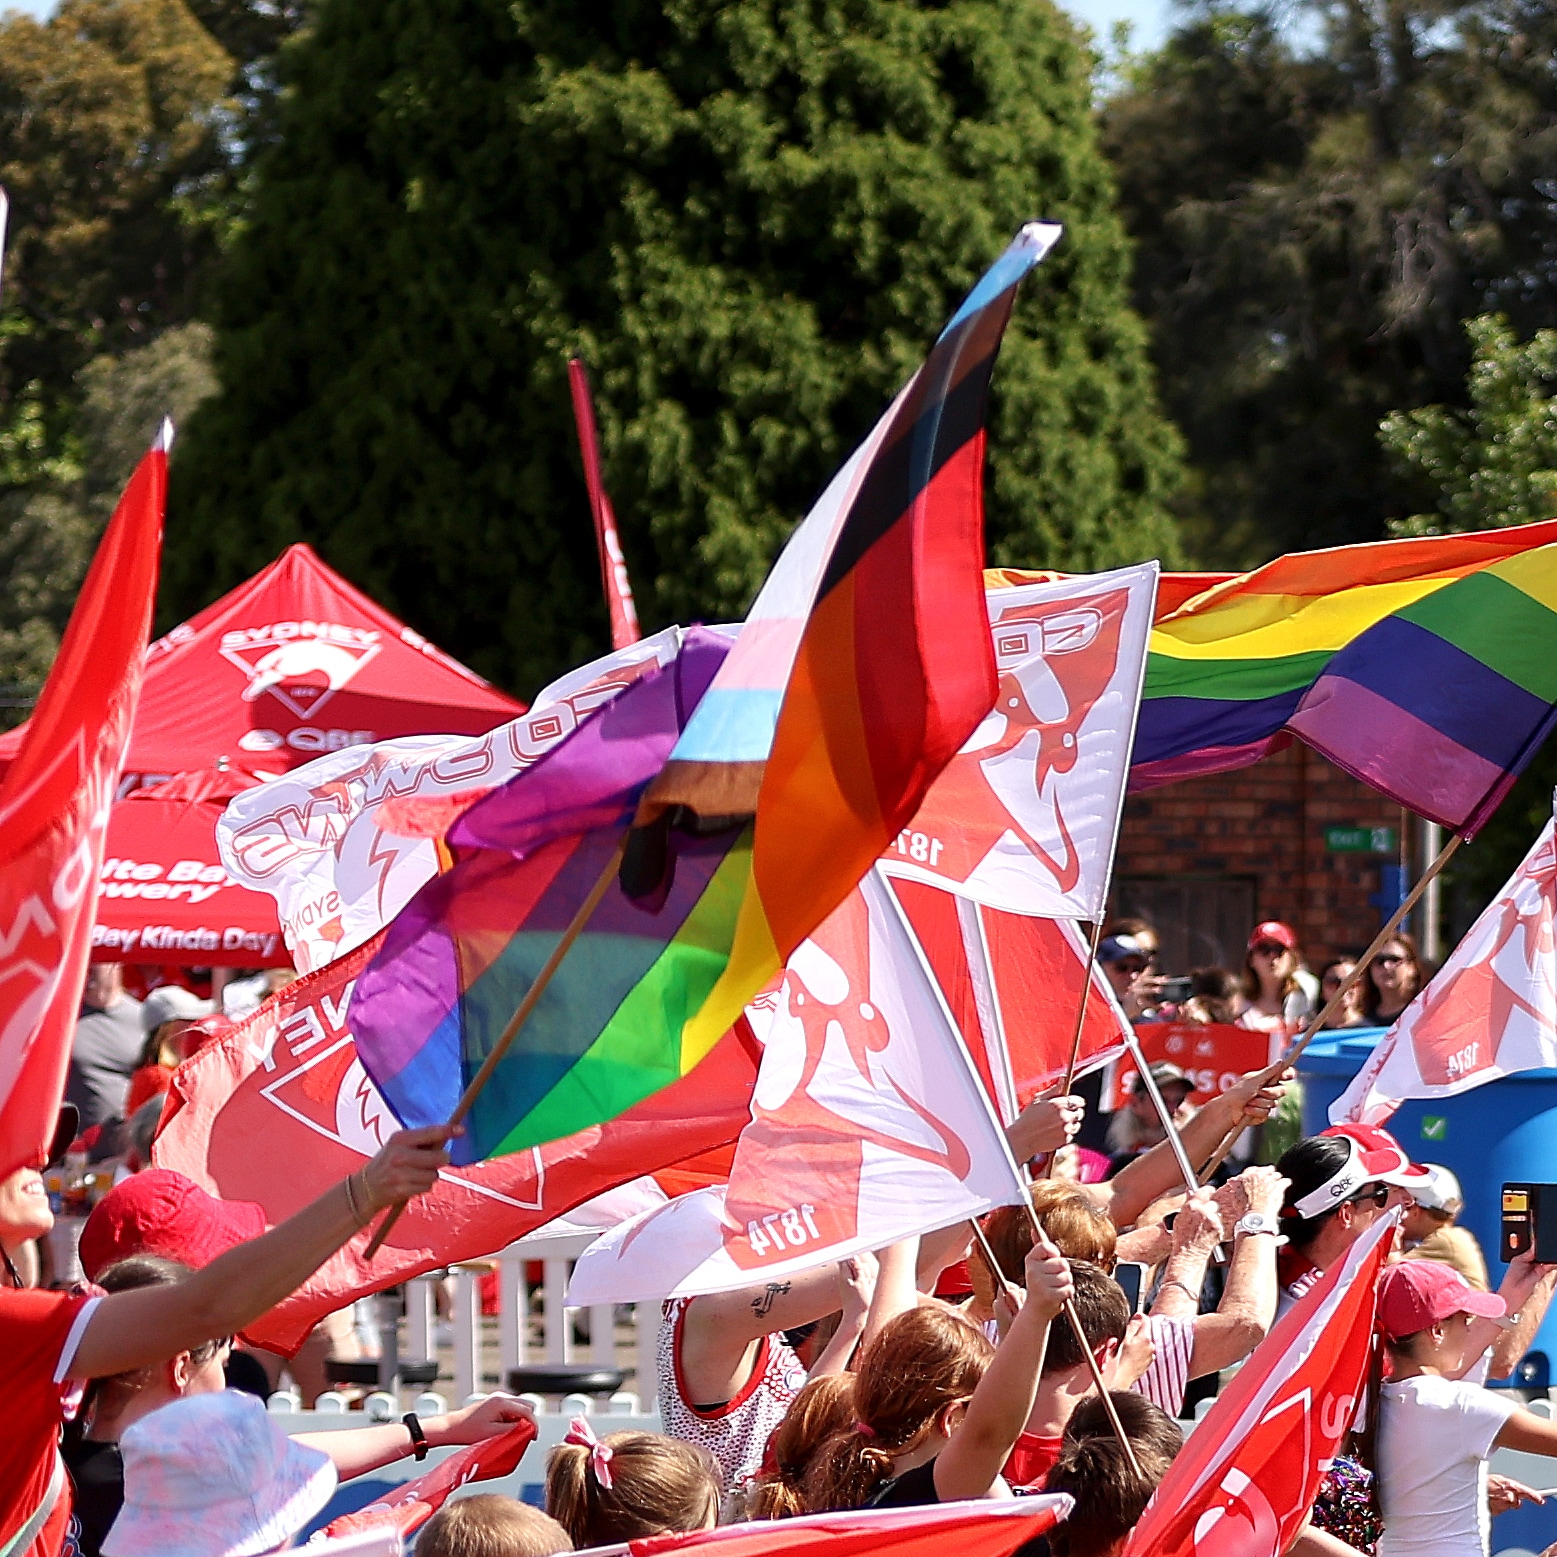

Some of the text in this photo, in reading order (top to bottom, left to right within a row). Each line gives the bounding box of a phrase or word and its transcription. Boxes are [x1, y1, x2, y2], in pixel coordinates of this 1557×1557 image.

[220, 621, 382, 644] SYDNEY
[140, 925, 219, 950] Kinda
[223, 927, 277, 956] Day
